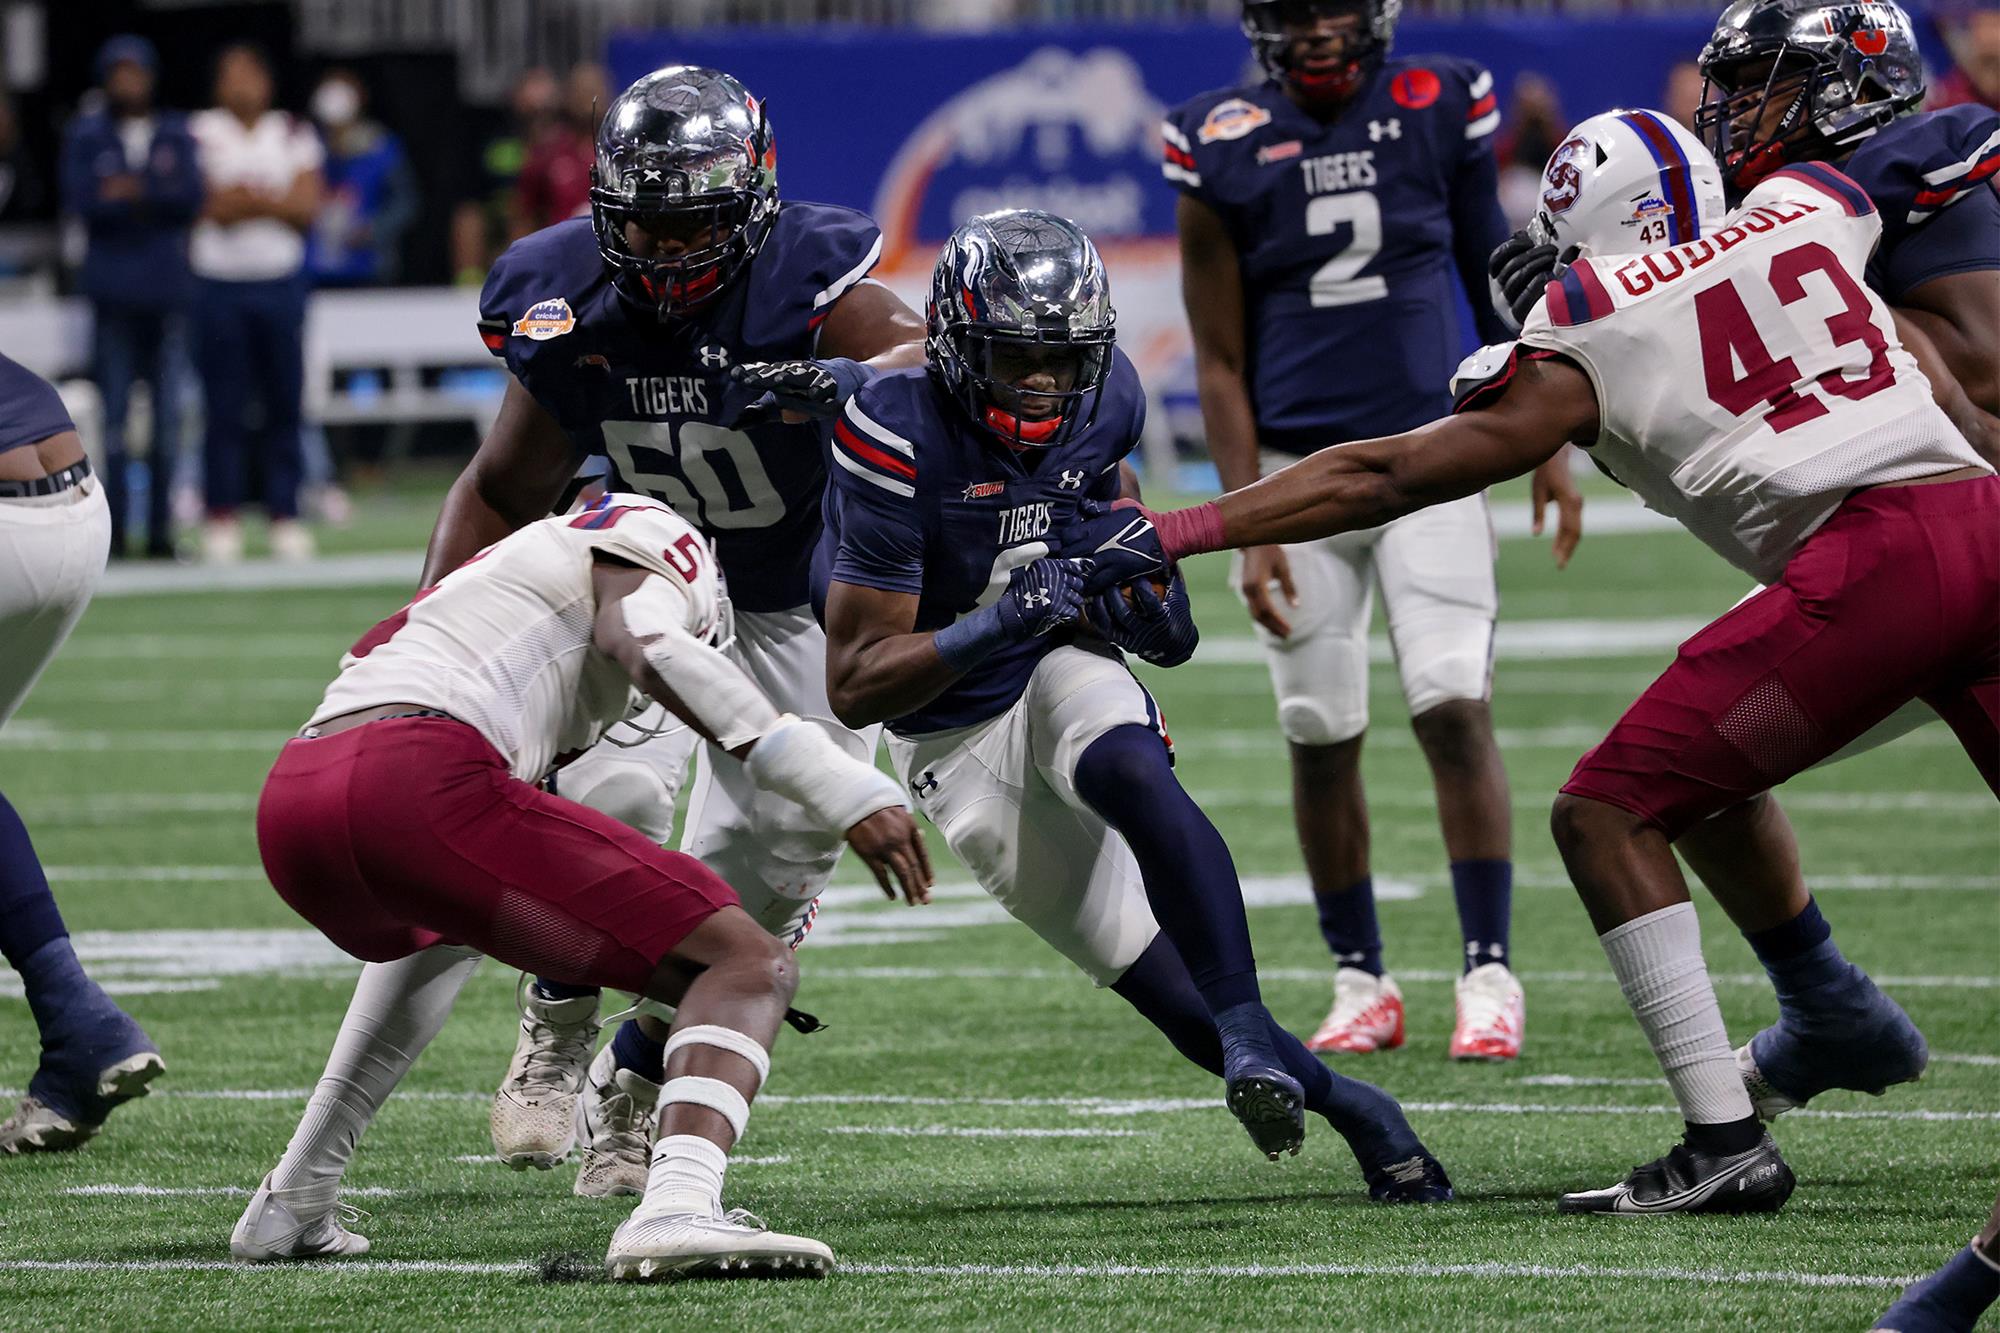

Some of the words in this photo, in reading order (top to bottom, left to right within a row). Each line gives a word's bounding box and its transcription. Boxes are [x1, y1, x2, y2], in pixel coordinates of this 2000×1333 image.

[1300, 150, 1378, 195] TIGERS
[1306, 190, 1389, 308] 2
[1639, 219, 1667, 245] 43
[1693, 240, 1897, 435] 43
[625, 376, 709, 416] TIGERS
[997, 501, 1056, 545] TIGERS
[663, 532, 705, 585] 5
